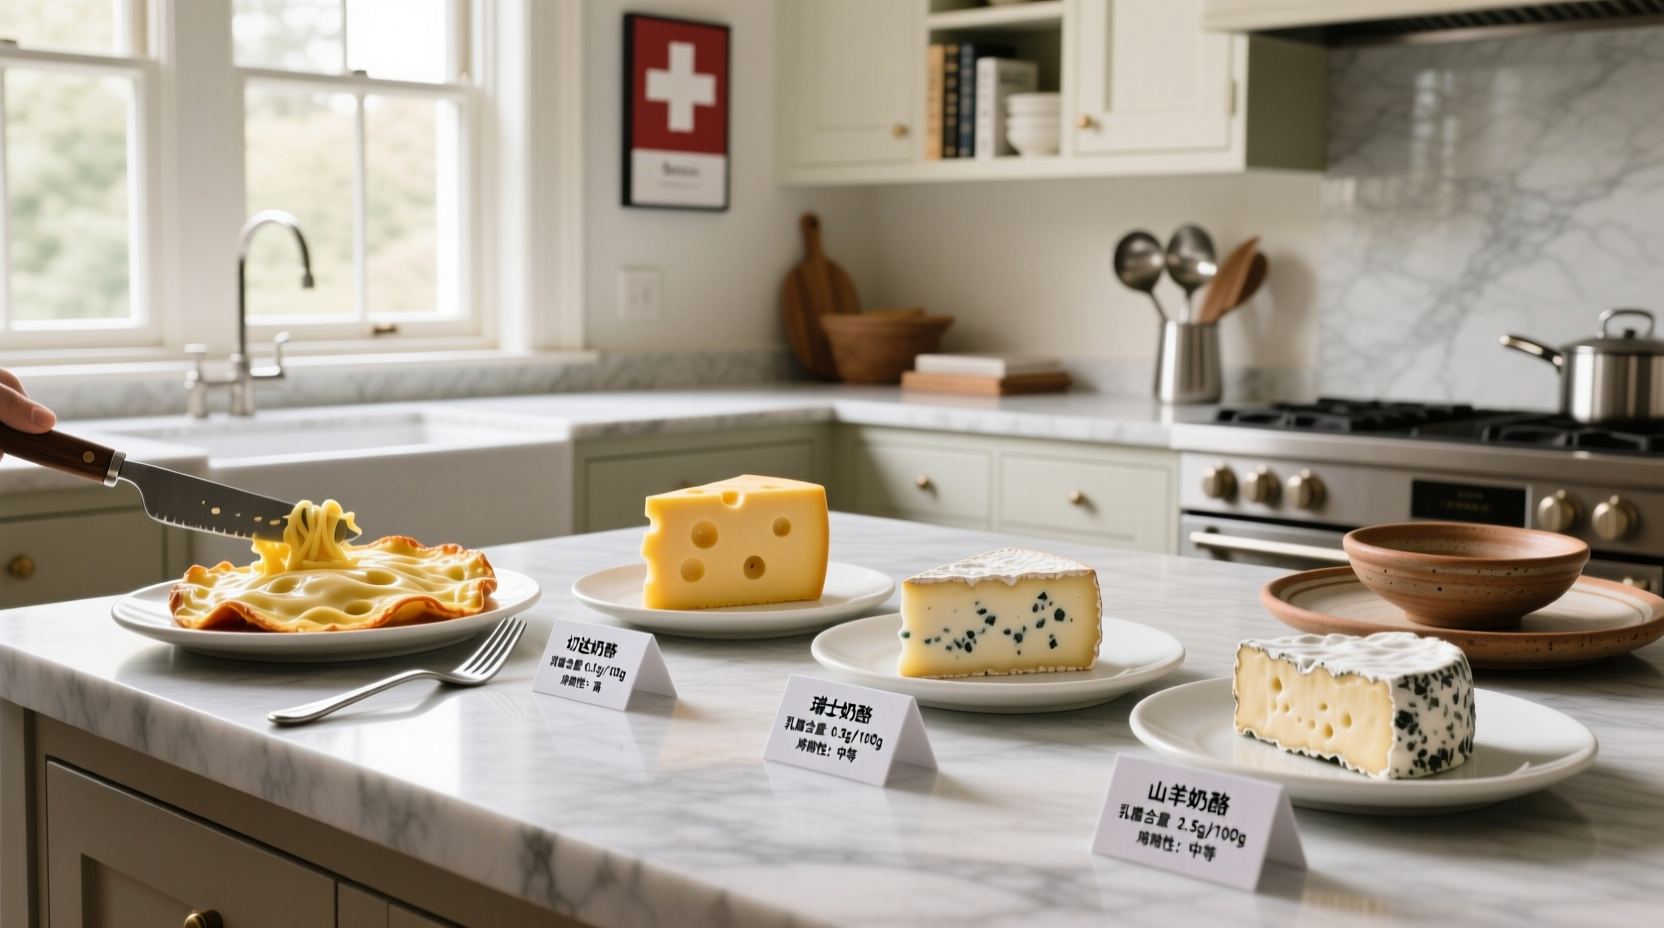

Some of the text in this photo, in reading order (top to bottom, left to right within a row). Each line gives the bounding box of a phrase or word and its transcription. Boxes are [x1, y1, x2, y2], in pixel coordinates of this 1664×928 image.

[810, 695, 873, 724] 瑞士奶酪
[1148, 781, 1231, 816] 山羊奶酪
[1177, 817, 1246, 848] 2.5g/100g
